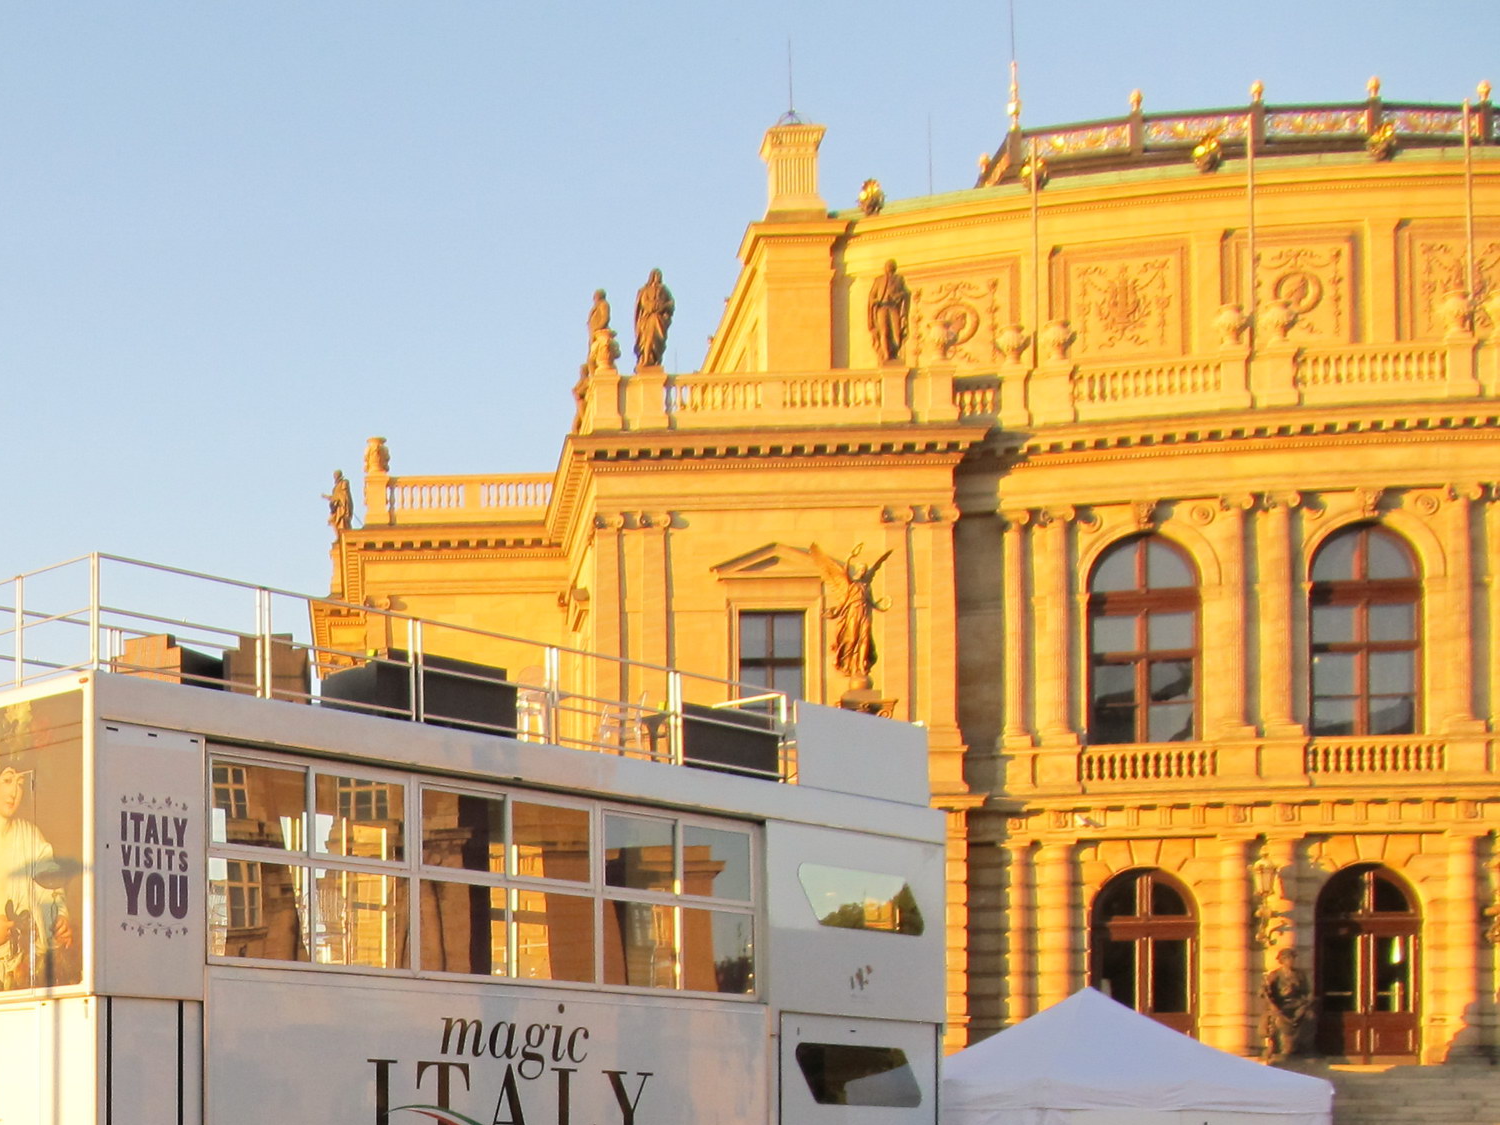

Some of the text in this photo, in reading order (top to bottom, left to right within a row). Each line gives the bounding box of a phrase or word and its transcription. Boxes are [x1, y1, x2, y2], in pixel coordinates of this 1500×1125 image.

[121, 811, 188, 848] ITALY
[121, 844, 188, 872] VISITS
[121, 869, 188, 919] YOU
[440, 1003, 590, 1080] magic
